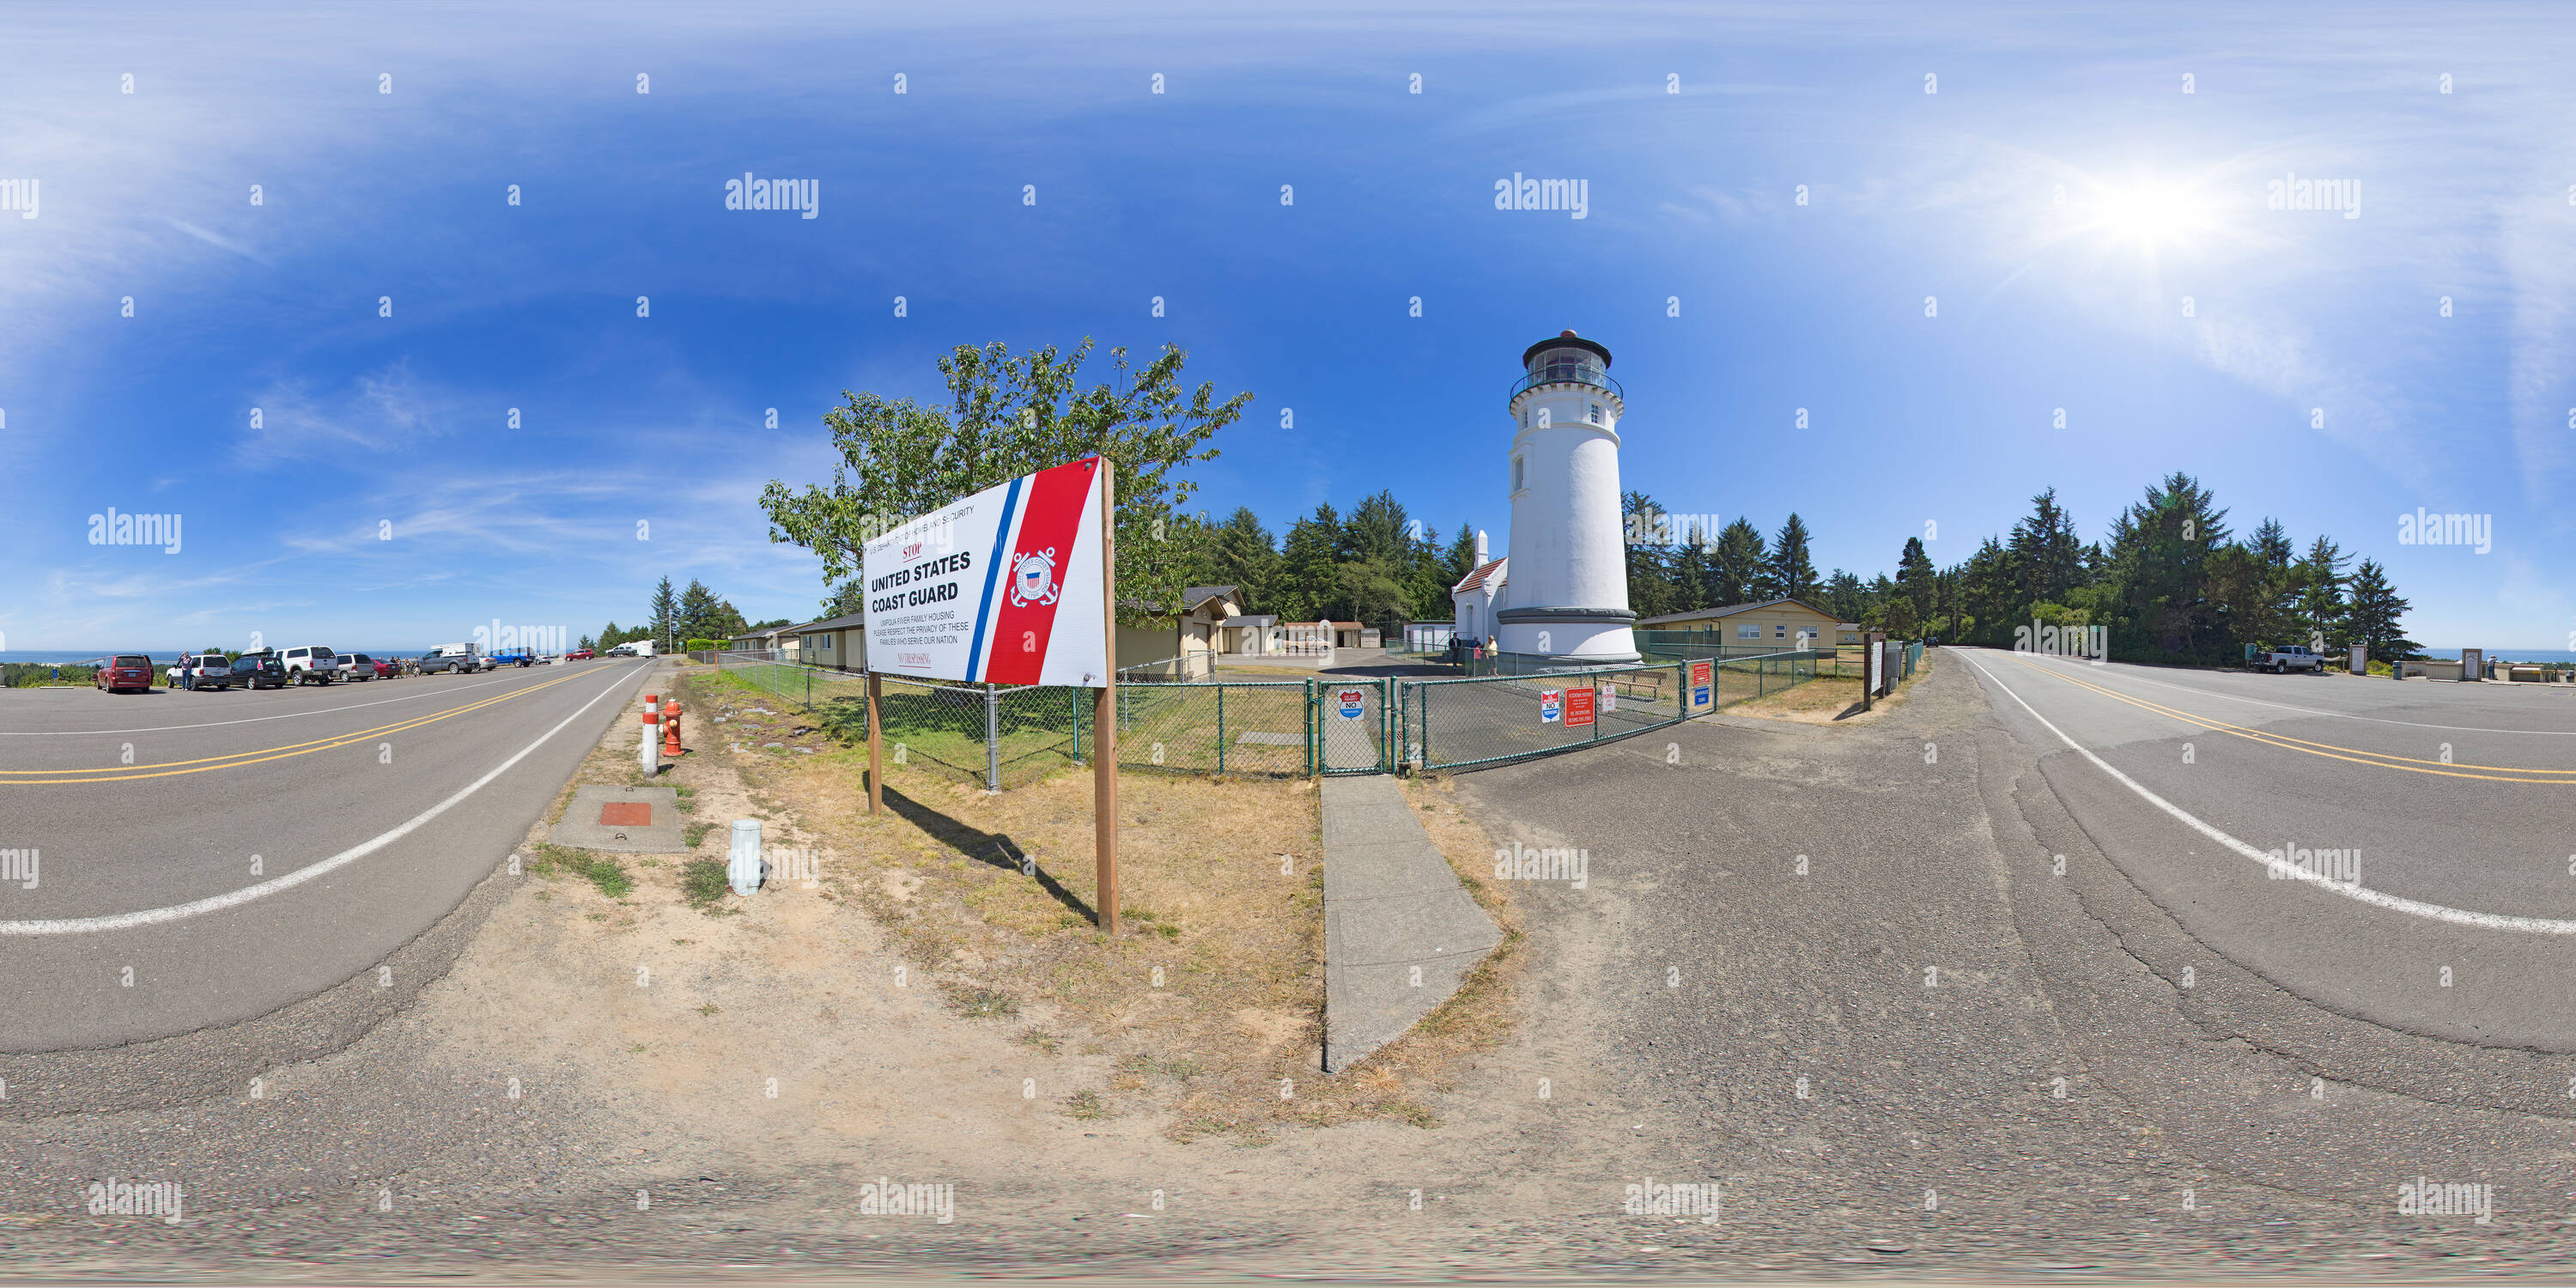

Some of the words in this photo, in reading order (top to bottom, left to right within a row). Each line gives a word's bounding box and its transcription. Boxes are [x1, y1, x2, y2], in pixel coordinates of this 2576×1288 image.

[911, 519, 941, 536] HOMELAND
[942, 505, 975, 525] SECURITY
[902, 542, 922, 559] STOP
[872, 568, 910, 592] UNITED
[914, 550, 971, 581] STATES
[872, 593, 906, 613] COAST
[908, 581, 958, 607] GUARD
[896, 616, 910, 624] RIVER
[910, 613, 927, 623] FAMILY
[928, 610, 955, 622] HOUSING
[873, 629, 887, 637] PLEASE
[887, 627, 906, 636] RESPECT
[906, 626, 915, 635] THE
[915, 623, 938, 635] PRIVACY
[939, 623, 947, 633] OF
[948, 621, 969, 632] THESE
[896, 637, 908, 646] WHO
[908, 636, 923, 645] SERVE
[923, 635, 935, 645] OUR
[936, 635, 957, 644] NATION
